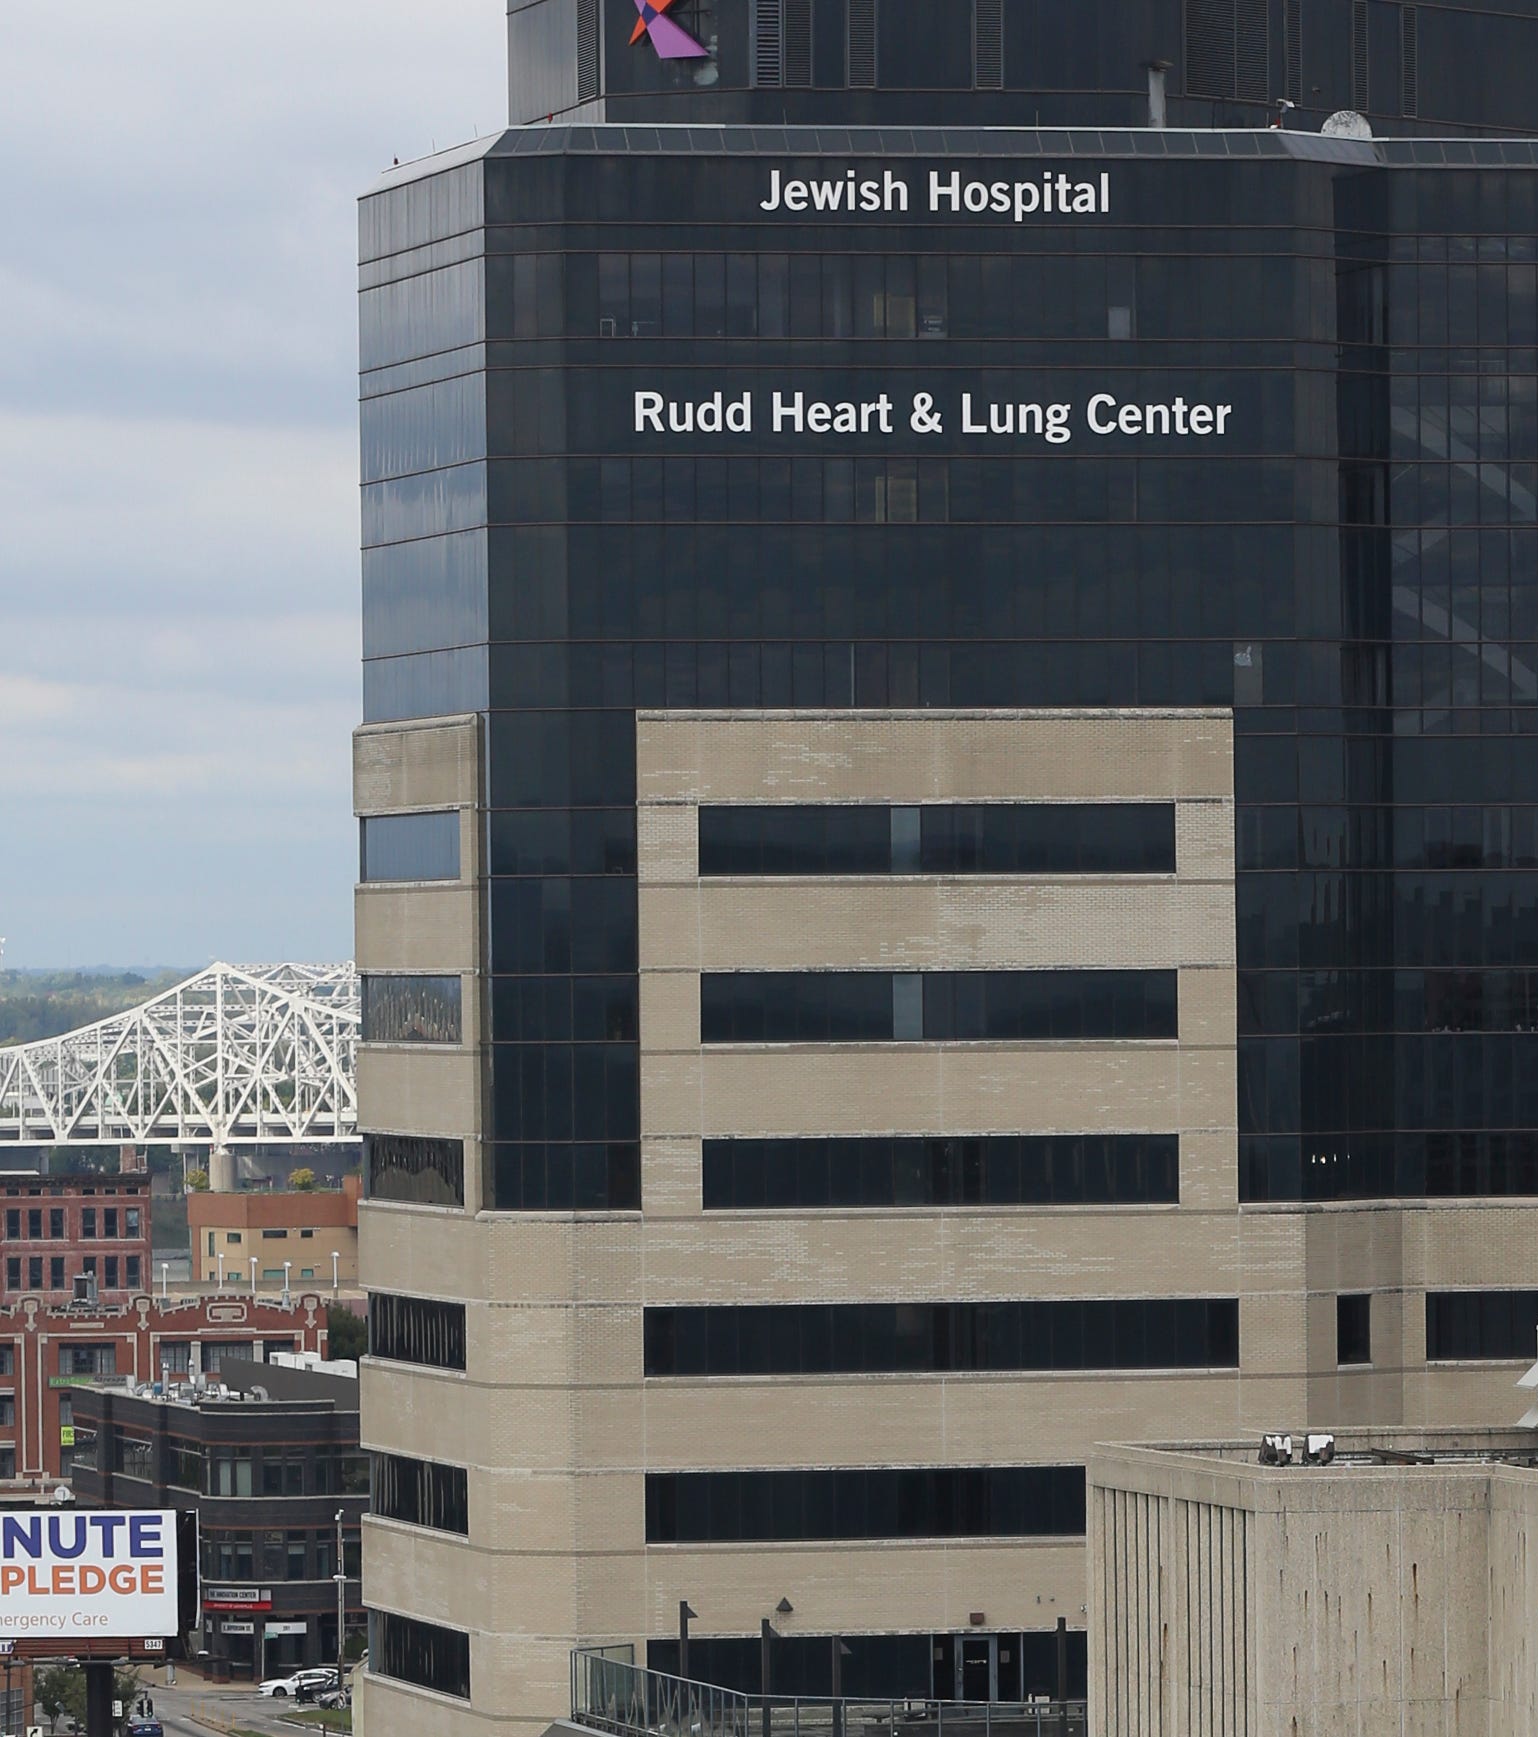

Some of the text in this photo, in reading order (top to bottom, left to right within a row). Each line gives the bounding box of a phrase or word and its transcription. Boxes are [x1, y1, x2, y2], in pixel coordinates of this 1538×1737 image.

[759, 169, 1110, 222] Jewish Hospital
[634, 391, 1232, 444] Rudd Heart & Lung Center
[2, 1515, 164, 1559] NUTE
[1, 1564, 165, 1595] PLEDGE
[71, 1611, 109, 1626] Care
[145, 1640, 162, 1649] 5347
